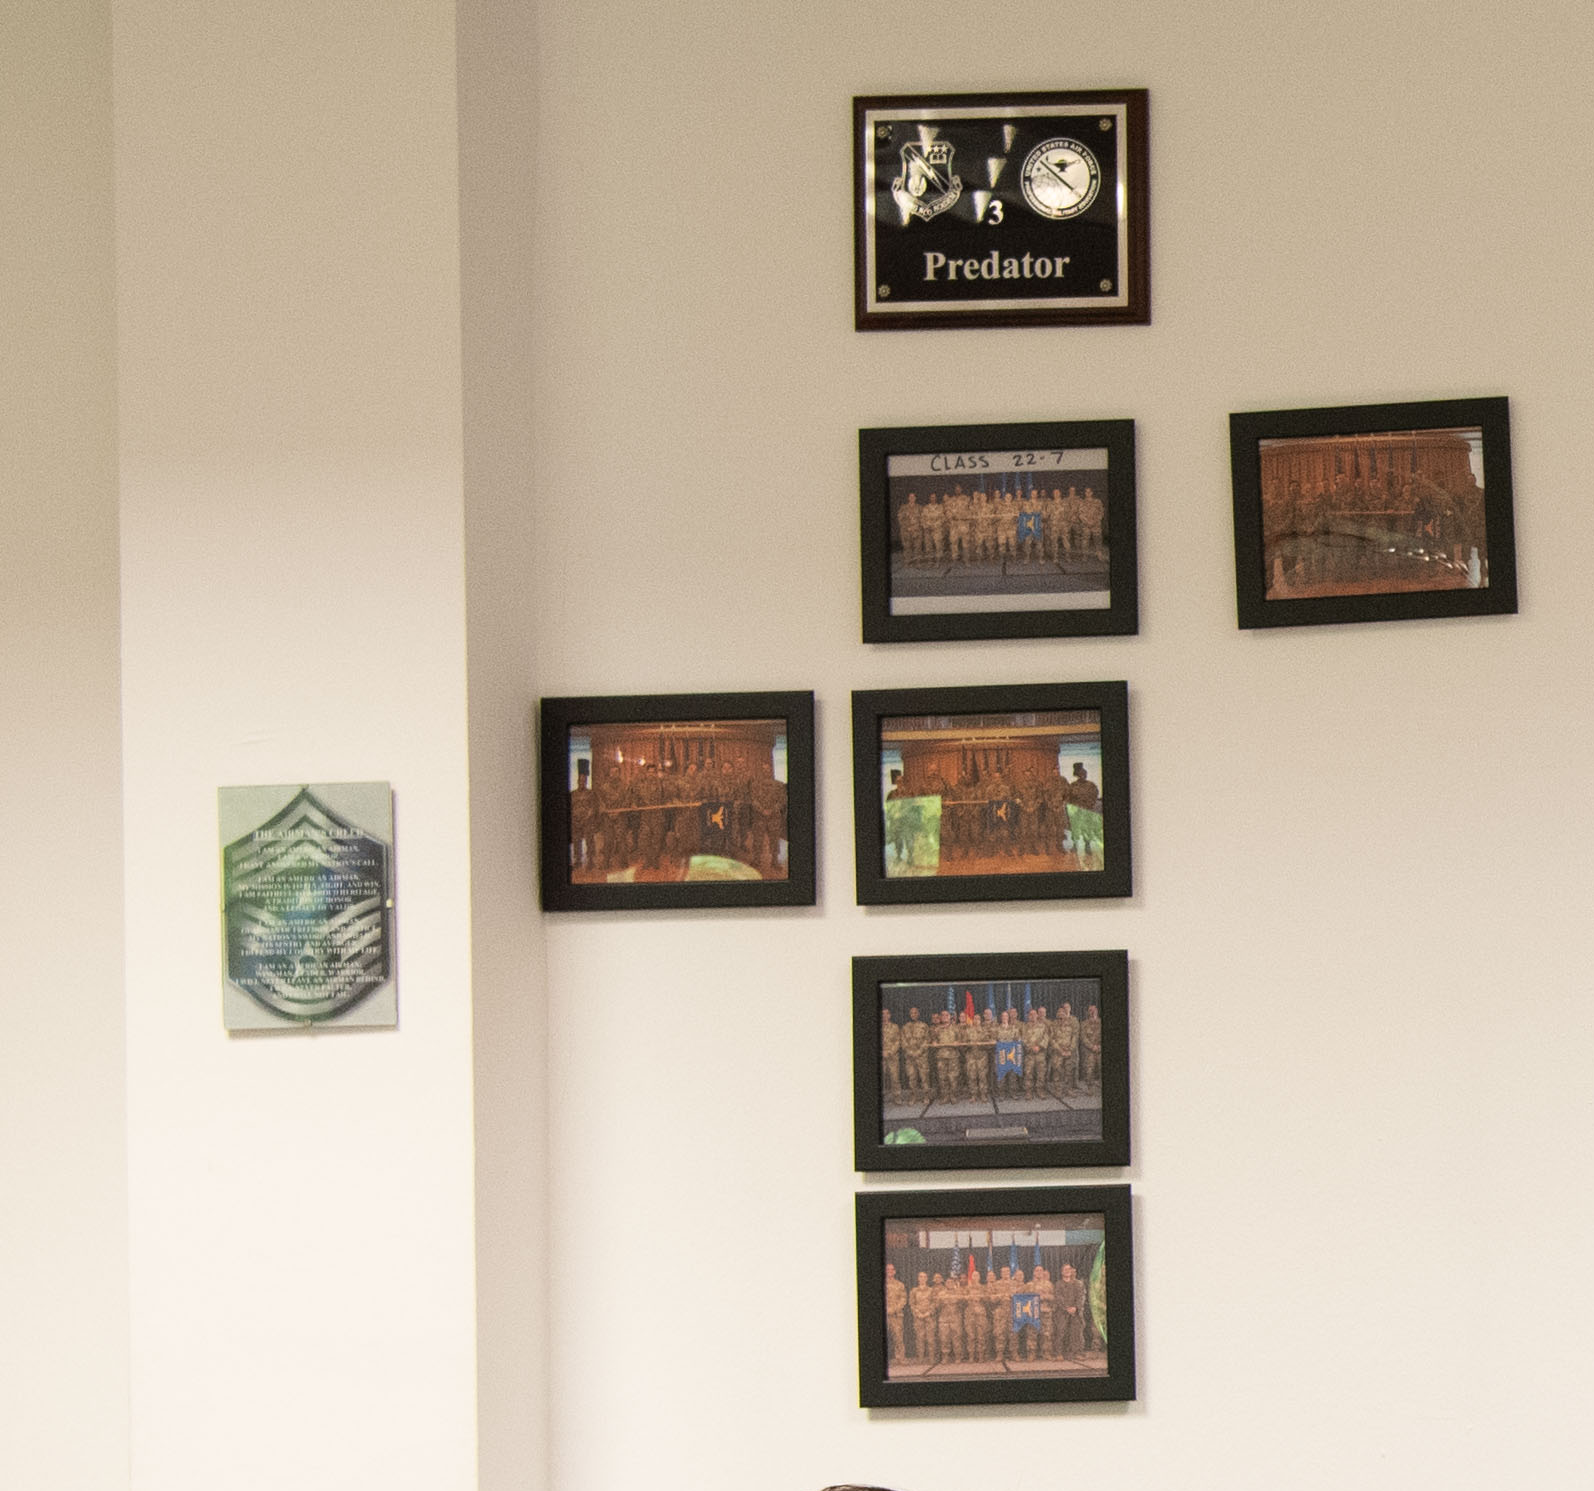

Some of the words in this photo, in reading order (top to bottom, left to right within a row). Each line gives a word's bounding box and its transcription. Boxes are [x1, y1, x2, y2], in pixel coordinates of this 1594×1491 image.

[988, 200, 1004, 225] 3
[923, 251, 1070, 281] Predator
[930, 454, 990, 472] CLASS
